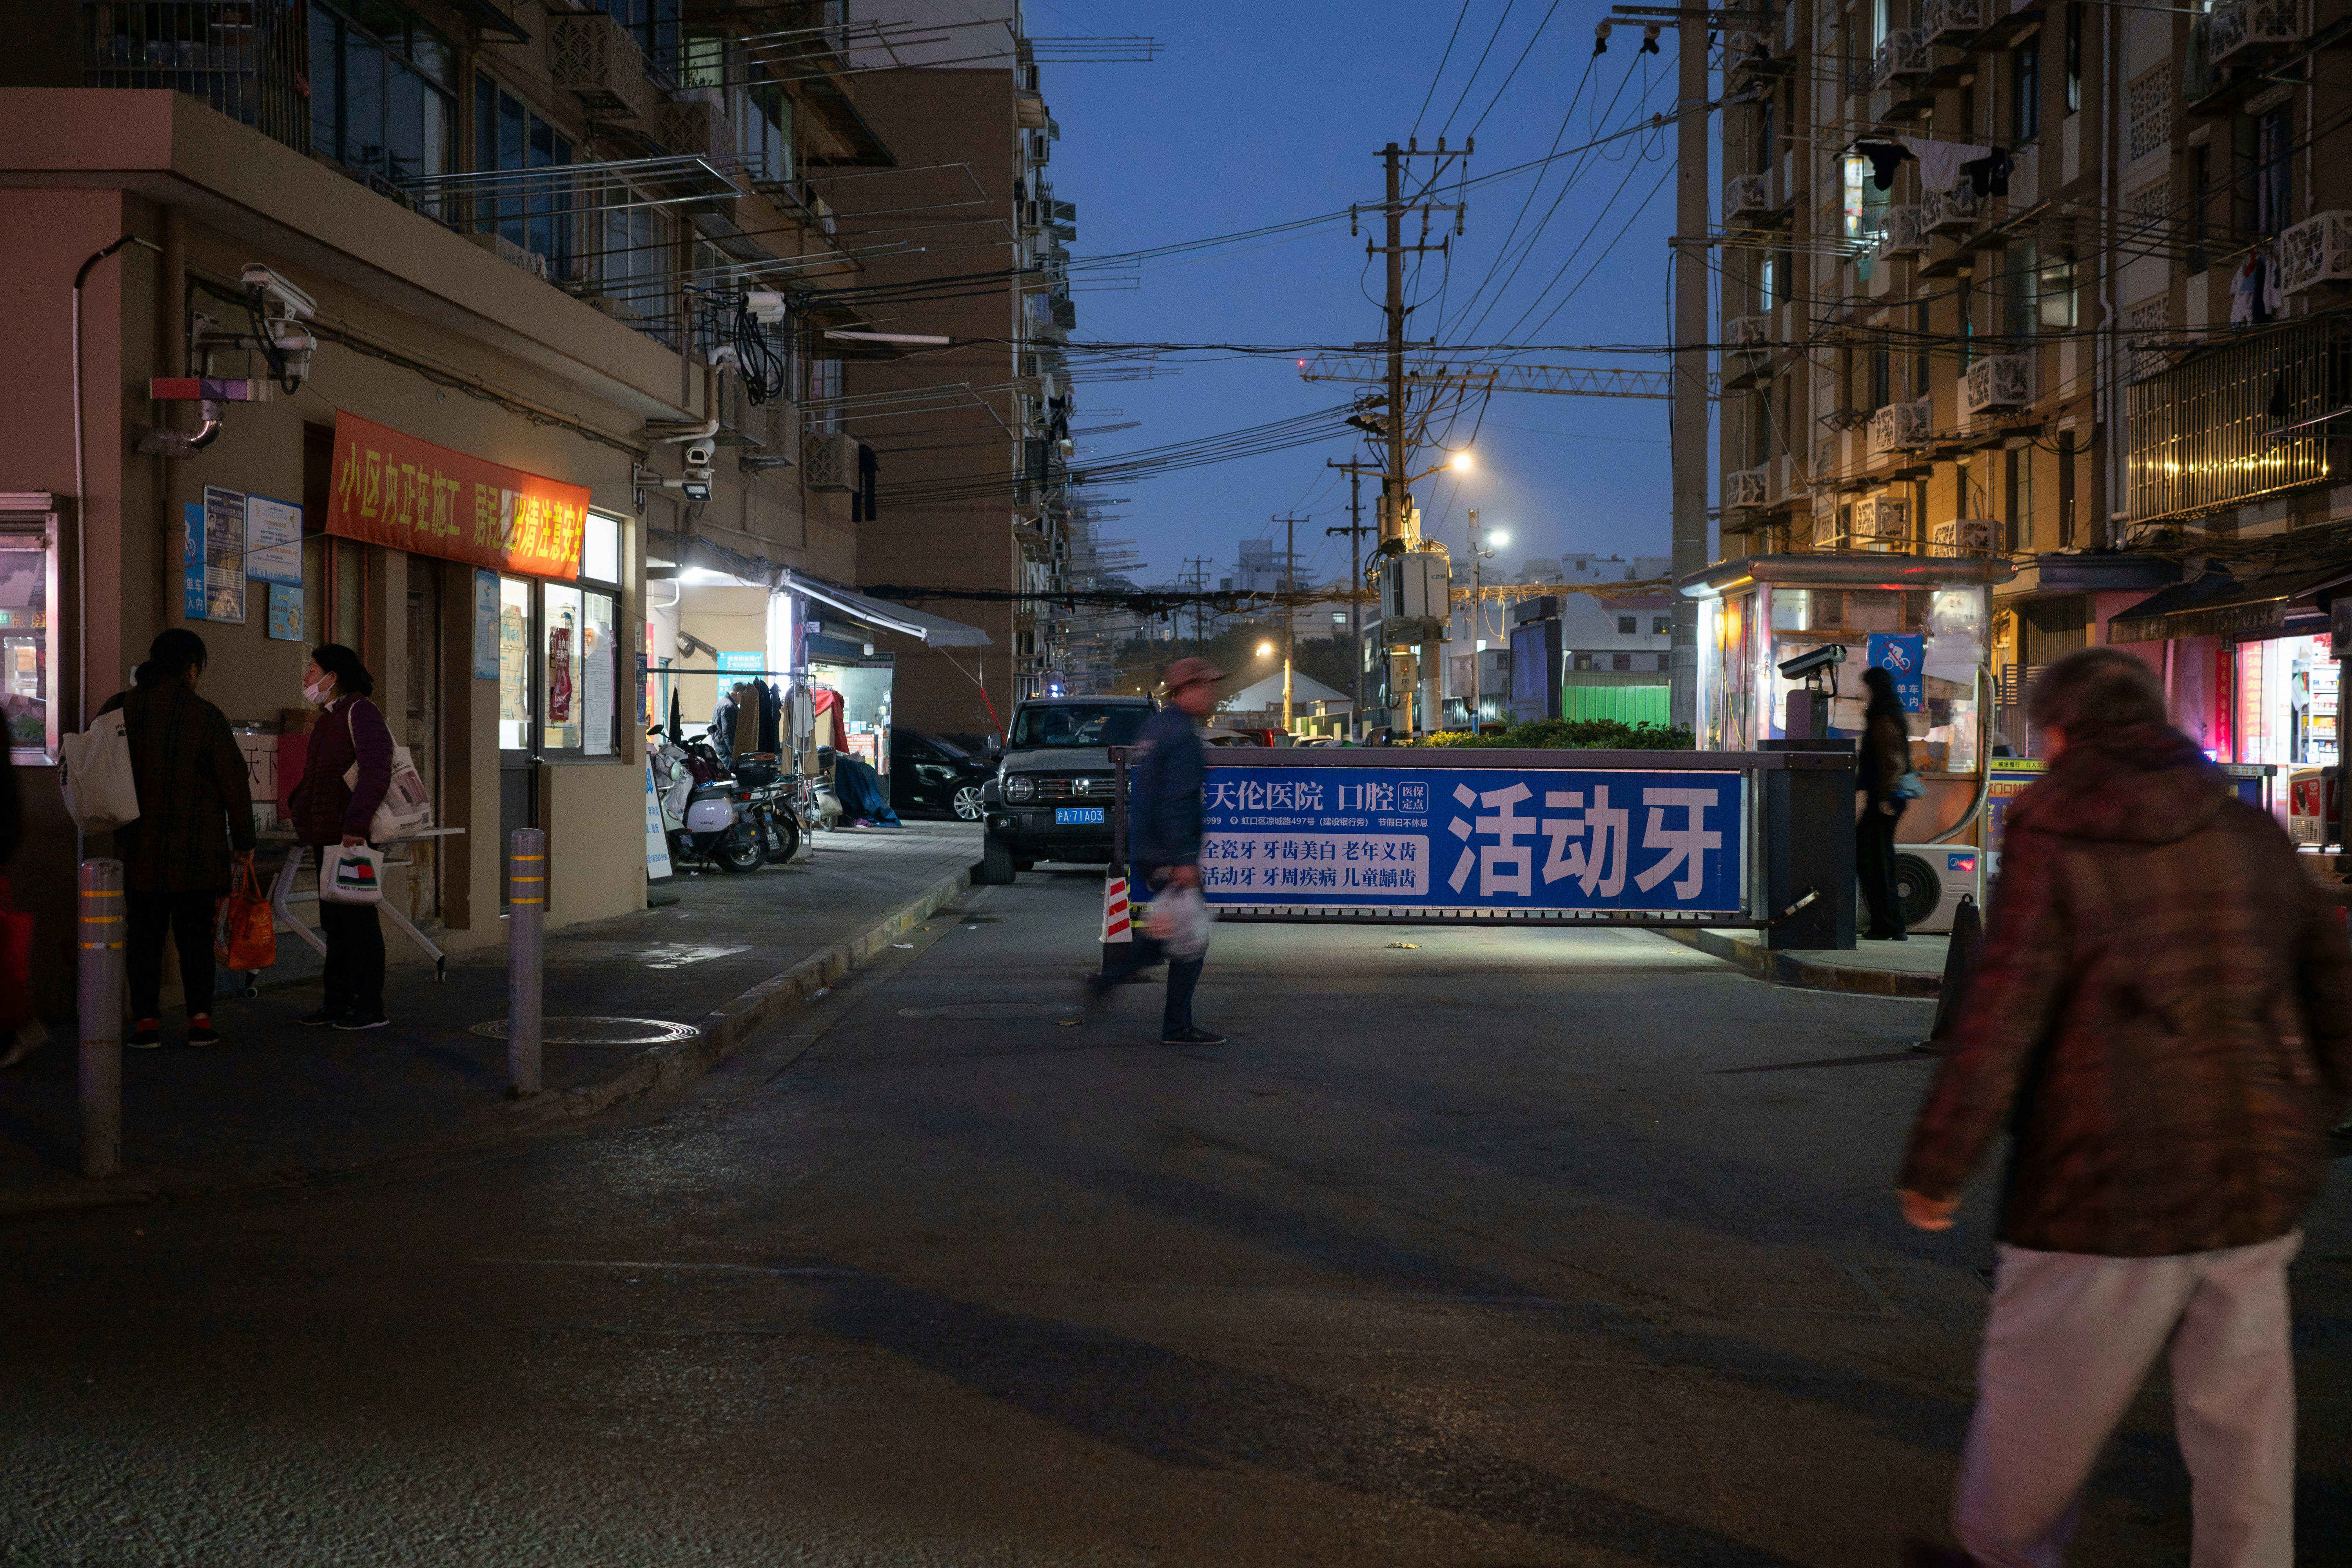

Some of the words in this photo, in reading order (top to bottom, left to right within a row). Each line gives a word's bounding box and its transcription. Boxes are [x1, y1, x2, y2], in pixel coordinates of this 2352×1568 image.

[338, 442, 460, 537] 小区内正在施工
[473, 483, 584, 563] 居民出请注意安全
[186, 577, 203, 593] 单车
[1897, 684, 1919, 694] 单车
[1339, 782, 1394, 811] 口腔
[1402, 786, 1424, 797] 医保
[1402, 799, 1424, 810] 定点
[1378, 818, 1428, 828] 节假日不休息
[1202, 839, 1256, 860] 全瓷牙
[1263, 840, 1336, 861] 牙齿美白
[1342, 841, 1417, 862] 老年义齿
[1447, 782, 1722, 900] 活动牙
[1202, 866, 1256, 886] 活动牙
[1263, 867, 1337, 887] 牙周疾病
[1342, 867, 1416, 888] 儿童龋齿
